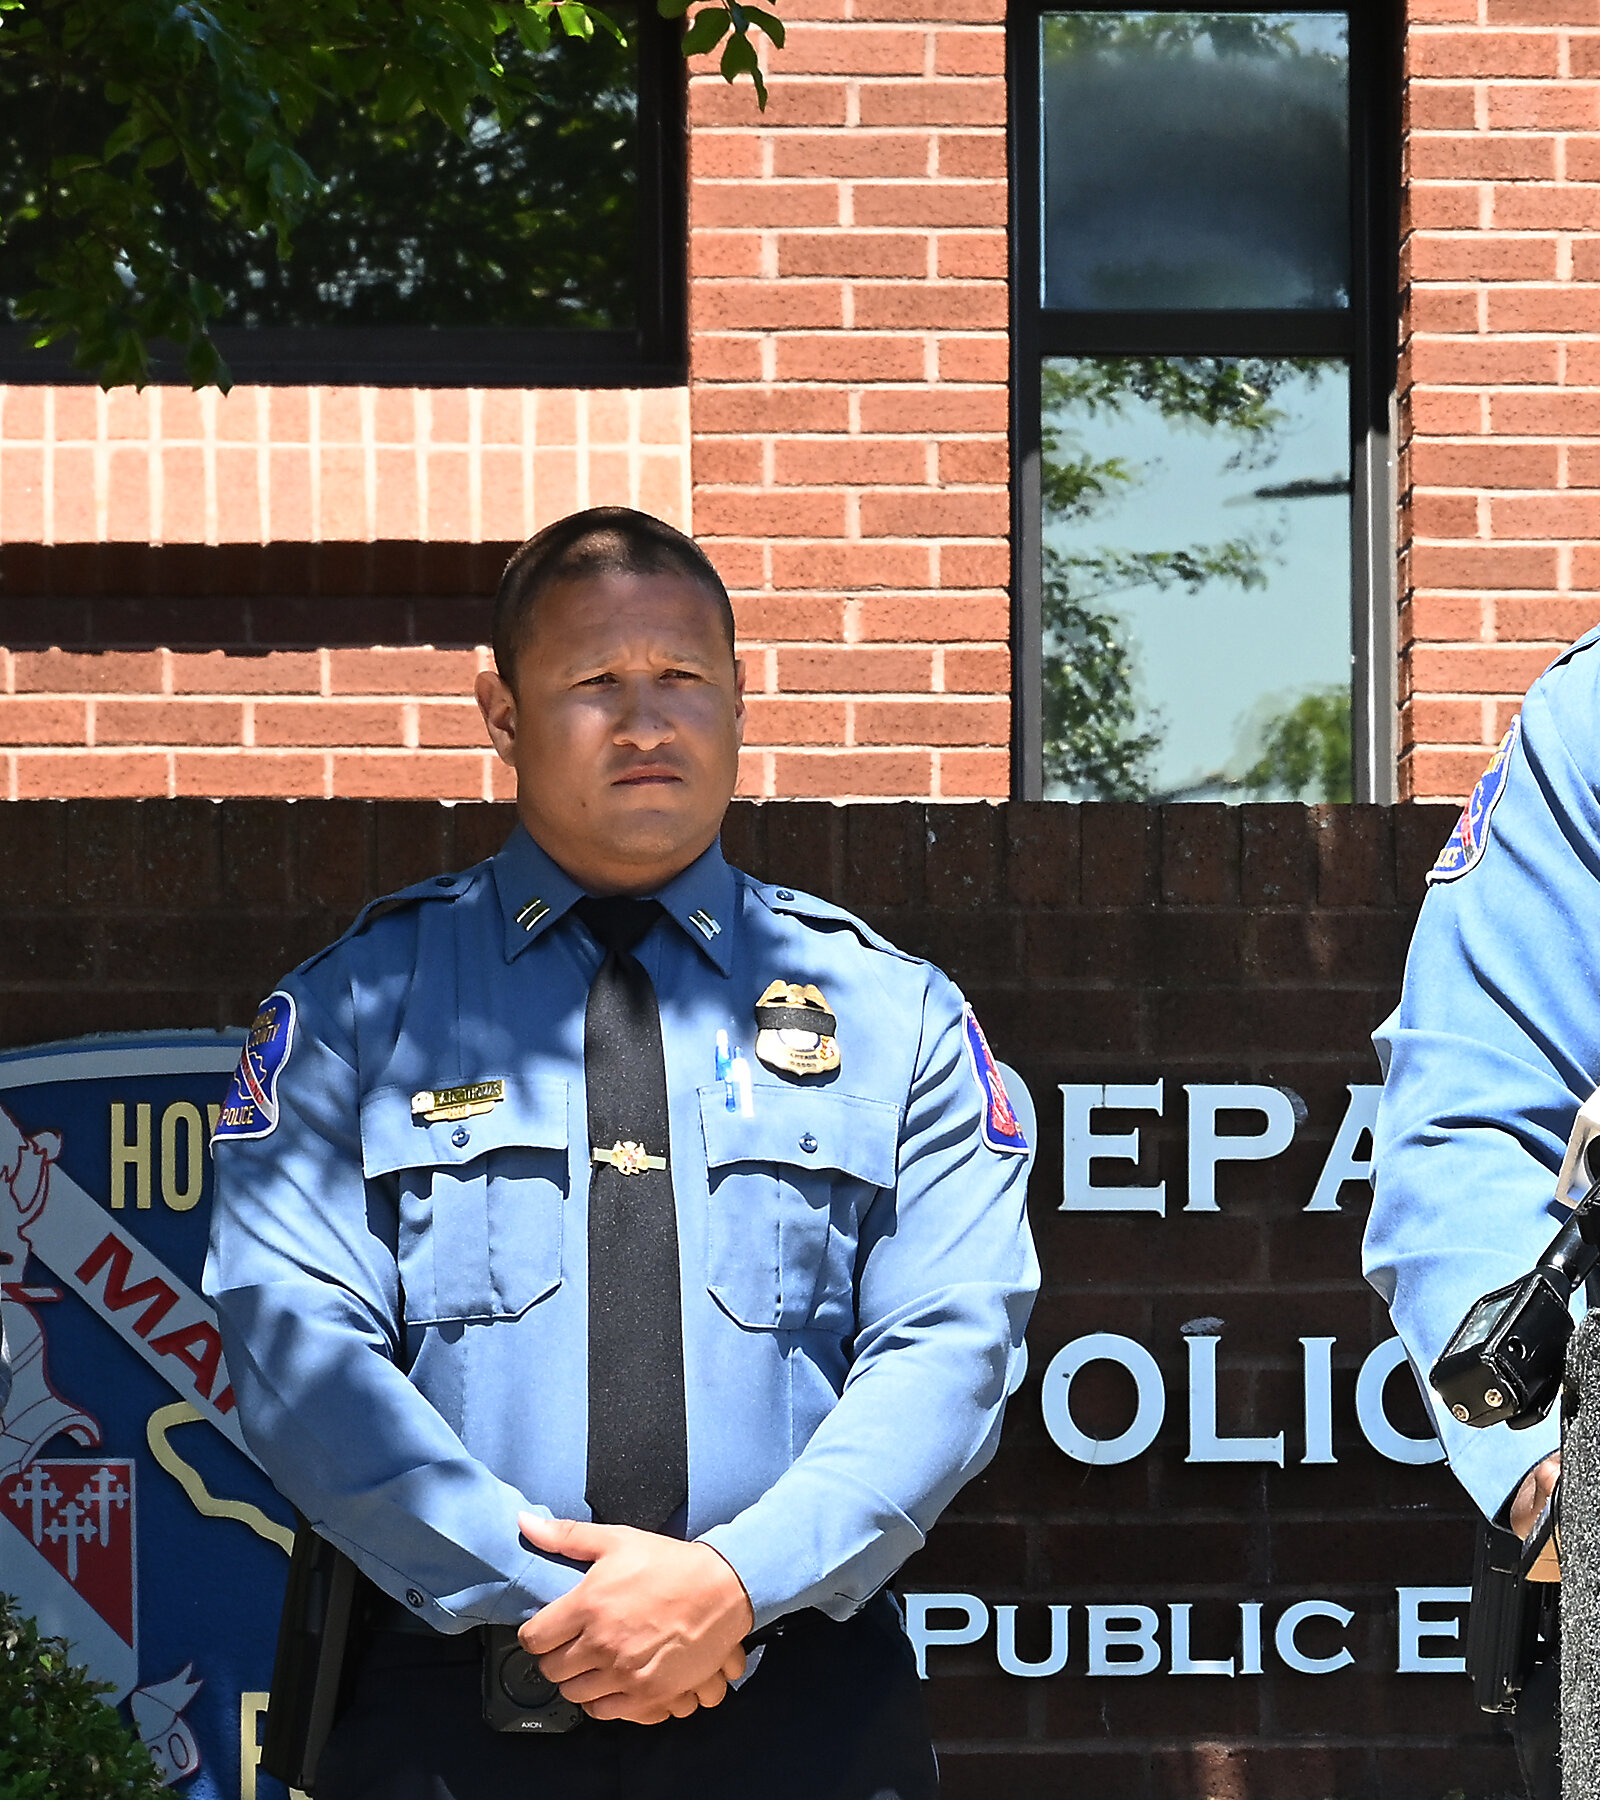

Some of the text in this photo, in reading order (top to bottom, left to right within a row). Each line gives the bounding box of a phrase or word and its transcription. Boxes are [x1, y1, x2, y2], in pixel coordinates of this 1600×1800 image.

[110, 1101, 221, 1211] HO
[221, 1105, 256, 1127] POLICE
[994, 1061, 1384, 1218] EPA
[74, 1232, 237, 1415] MA
[1010, 1333, 1447, 1467] OLIC
[903, 1592, 1356, 1681] PUBLIC
[521, 1721, 543, 1729] AXON
